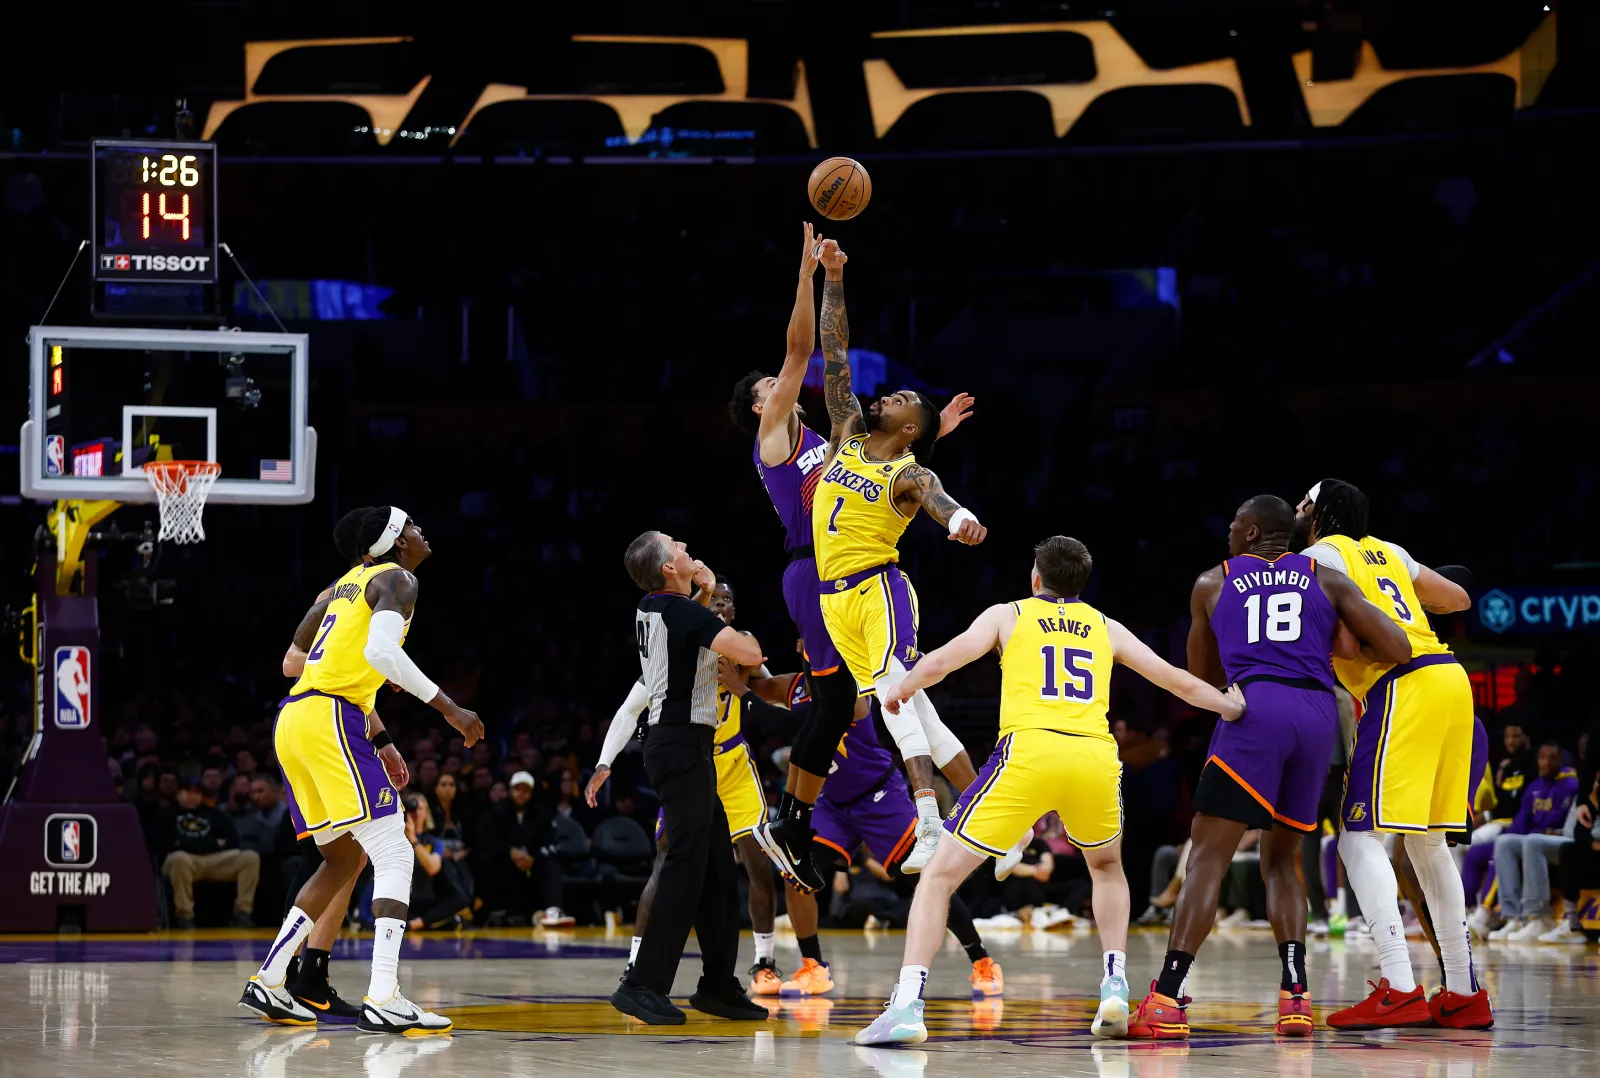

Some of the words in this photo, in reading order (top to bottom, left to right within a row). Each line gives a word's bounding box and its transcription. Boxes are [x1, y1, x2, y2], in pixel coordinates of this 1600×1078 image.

[143, 155, 199, 187] 1:26
[817, 176, 845, 211] Wilson
[142, 192, 190, 241] 14
[131, 255, 210, 272] TISSOT
[823, 460, 884, 503] LAKERS
[827, 496, 845, 534] 1
[1232, 570, 1311, 594] BIYOMBO
[1376, 577, 1413, 622] 3
[1037, 617, 1092, 639] REAVES
[1243, 591, 1303, 644] 18
[1521, 594, 1600, 630] cryp
[306, 613, 337, 663] 2
[1041, 645, 1094, 703] 15
[60, 708, 78, 723] NBA
[30, 871, 55, 895] GET
[57, 871, 82, 895] THE
[84, 872, 110, 896] APP
